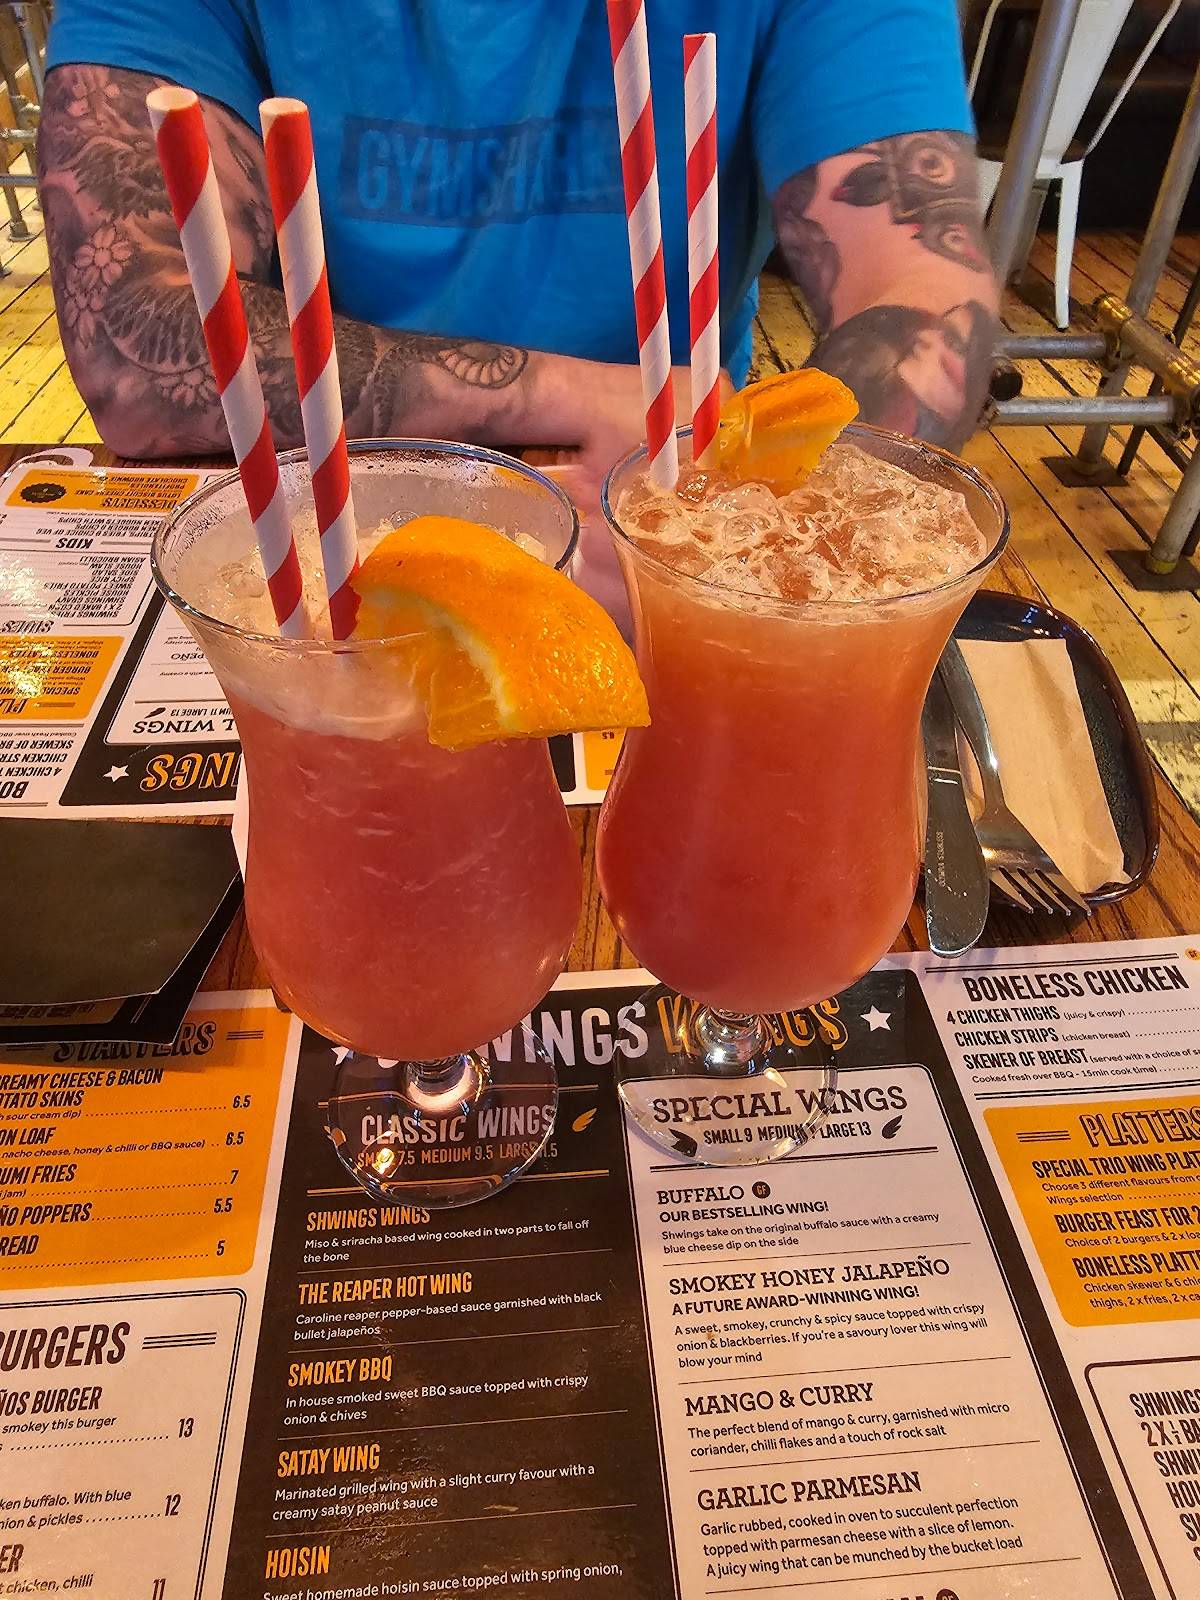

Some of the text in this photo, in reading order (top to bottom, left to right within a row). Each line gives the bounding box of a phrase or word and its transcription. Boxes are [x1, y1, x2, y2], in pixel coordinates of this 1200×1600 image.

[55, 538, 93, 549] KIDS
[171, 708, 208, 717] LARGE 13
[132, 720, 215, 734] WINGS
[15, 740, 74, 749] SKEWER OF
[22, 753, 68, 763] CHICKEN
[6, 767, 53, 777] CHICKEN
[962, 965, 1190, 1002] BONELESS CHICKEN
[947, 1005, 1126, 1025] 4 CHICKEN THIGHS (juicy & crispy)
[954, 1027, 1131, 1048] CHICKEN STRIPS (chicken breast)
[962, 1048, 1089, 1070] SKEWER OF BREAST
[0, 1068, 163, 1090] REAMY CHEESE & BACON
[0, 1091, 40, 1110] OTATO
[232, 1095, 251, 1108] 6.5
[653, 1085, 908, 1123] SPECIAL WINGS
[6, 1109, 83, 1121] sour cream dip)
[361, 1104, 556, 1147] CLASSIC WINGS
[20, 1127, 56, 1145] LOAF
[703, 1127, 742, 1145] SMALL
[744, 1126, 753, 1141] 9
[821, 1121, 857, 1139] LARGE
[858, 1121, 872, 1137] 13
[1079, 1106, 1200, 1147] PLATTERS
[225, 1131, 244, 1145] 6.5
[1, 1149, 34, 1160] nacho
[34, 1148, 72, 1158] cheese,
[73, 1147, 105, 1157] honey
[114, 1144, 138, 1153] chilli
[150, 1141, 174, 1151] BBQ
[173, 1139, 206, 1150] sauce)
[421, 1144, 494, 1165] MEDIUM 9.5
[32, 1164, 77, 1183] FRIES
[230, 1169, 239, 1184] 7
[1031, 1153, 1167, 1179] SPECIAL TRIO WING
[1041, 1174, 1195, 1192] Choose 3 different flavours from
[213, 1198, 232, 1213] 5.5
[656, 1185, 745, 1205] BUFFALO
[1047, 1193, 1124, 1206] Wings selection
[20, 1202, 92, 1225] POPPERS
[306, 1206, 434, 1232] SHWINGS WINGS
[659, 1201, 830, 1224] OUR BESTSELLING WING!
[1055, 1206, 1195, 1234] BURGER FEAST FOR
[661, 1213, 940, 1241] Shwings take on the original buffalo sauce with a creamy
[216, 1240, 225, 1255] 5
[669, 1256, 951, 1296] SMOKEY HONEY JALAPEÑO
[1072, 1253, 1153, 1278] BONELESS
[298, 1272, 473, 1306] THE REAPER HOT WING
[672, 1285, 920, 1317] A FUTURE AWARD-WINNING WING!
[294, 1325, 384, 1342] bullet jalapeños
[288, 1355, 395, 1388] SMOKEY BBQ
[31, 1386, 103, 1414] BURGER
[286, 1375, 589, 1409] In house smoked sweet BBQ sauce topped with crispy
[684, 1382, 874, 1418] MANGO & CURRY
[2, 1417, 118, 1435] smokey this burger
[178, 1417, 194, 1438] 13
[277, 1444, 381, 1479] SATAY WING
[23, 1489, 133, 1510] buffalo. With blue
[697, 1471, 923, 1512] GARLIC PARMESAN
[165, 1494, 181, 1516] 12
[264, 1545, 331, 1579] HOISIN
[152, 1578, 166, 1600] 11
